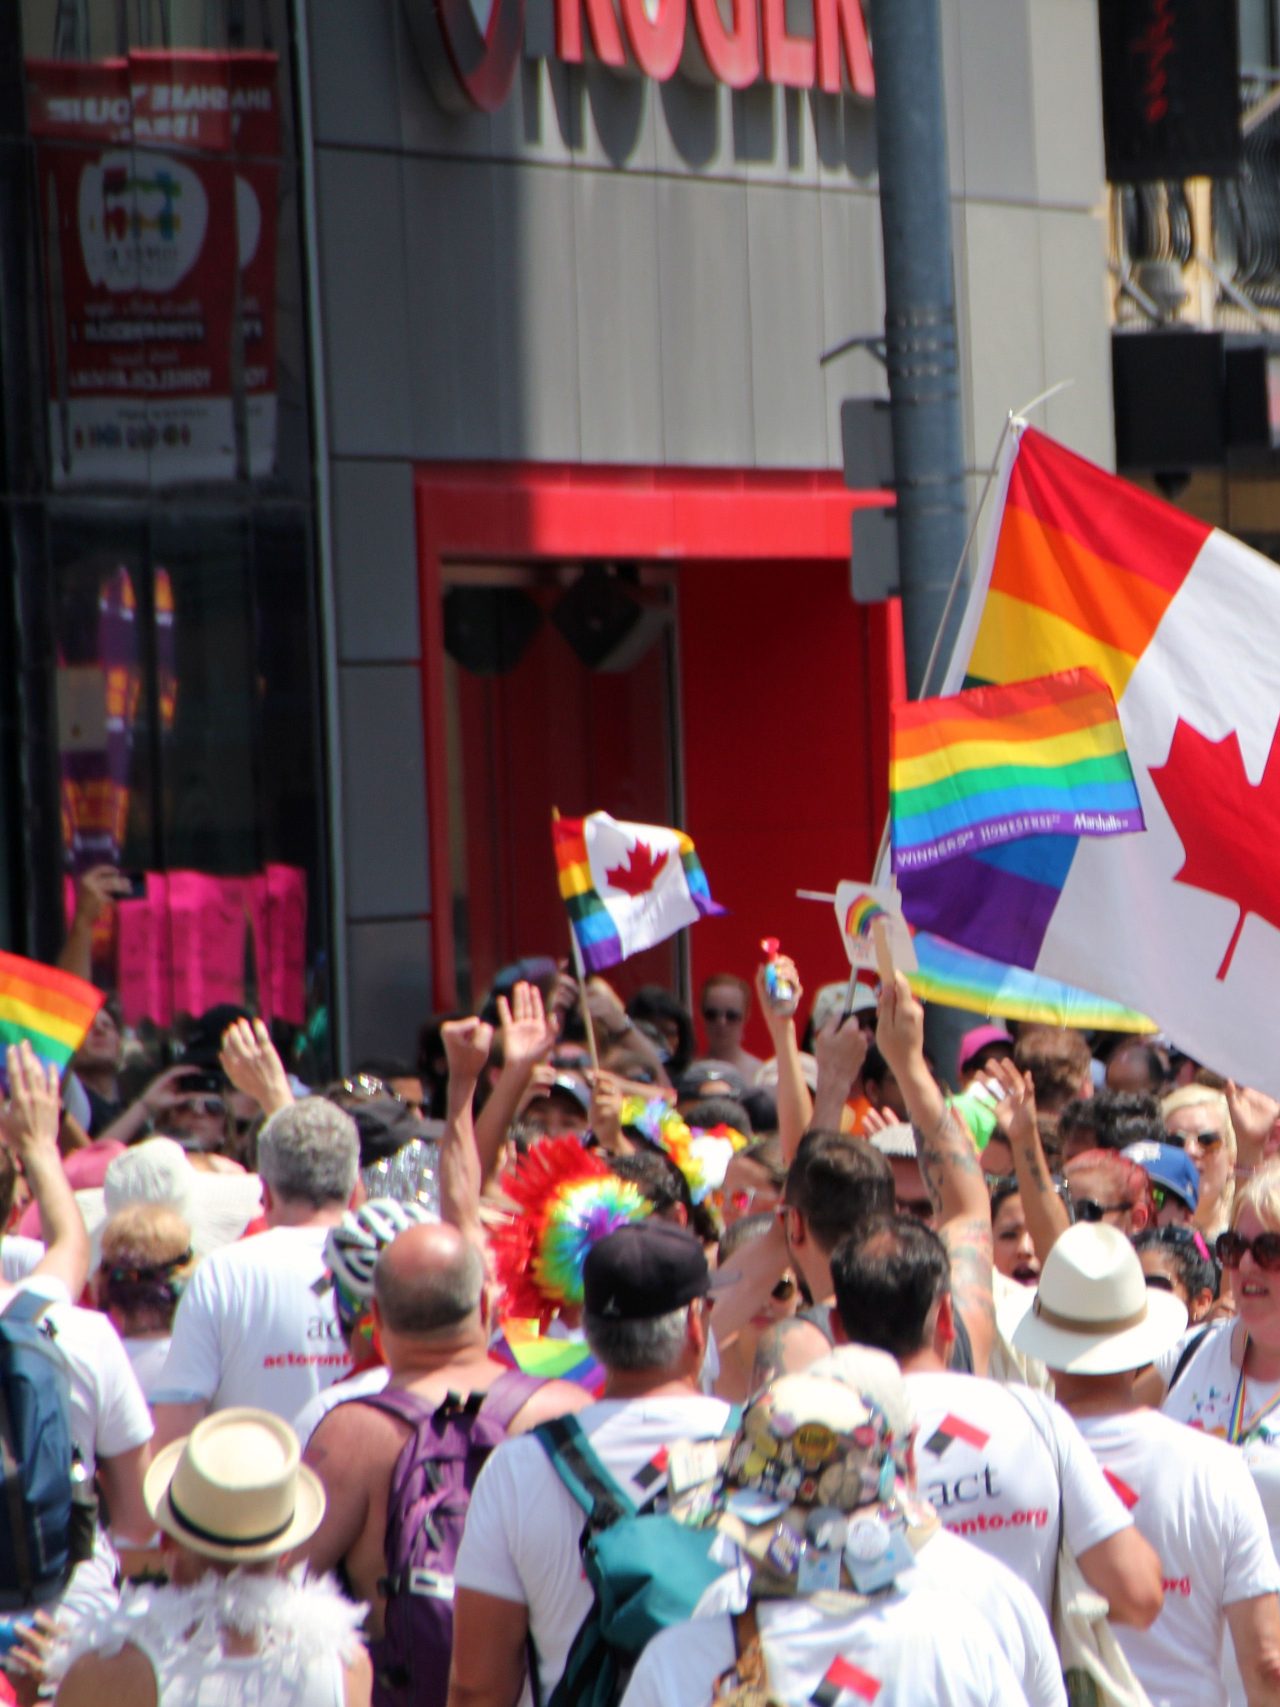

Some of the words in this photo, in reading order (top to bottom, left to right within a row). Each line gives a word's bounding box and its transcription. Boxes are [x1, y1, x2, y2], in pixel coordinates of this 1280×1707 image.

[897, 834, 967, 867] WINNERS
[1073, 812, 1121, 832] Marshalls
[928, 1462, 1001, 1508] act
